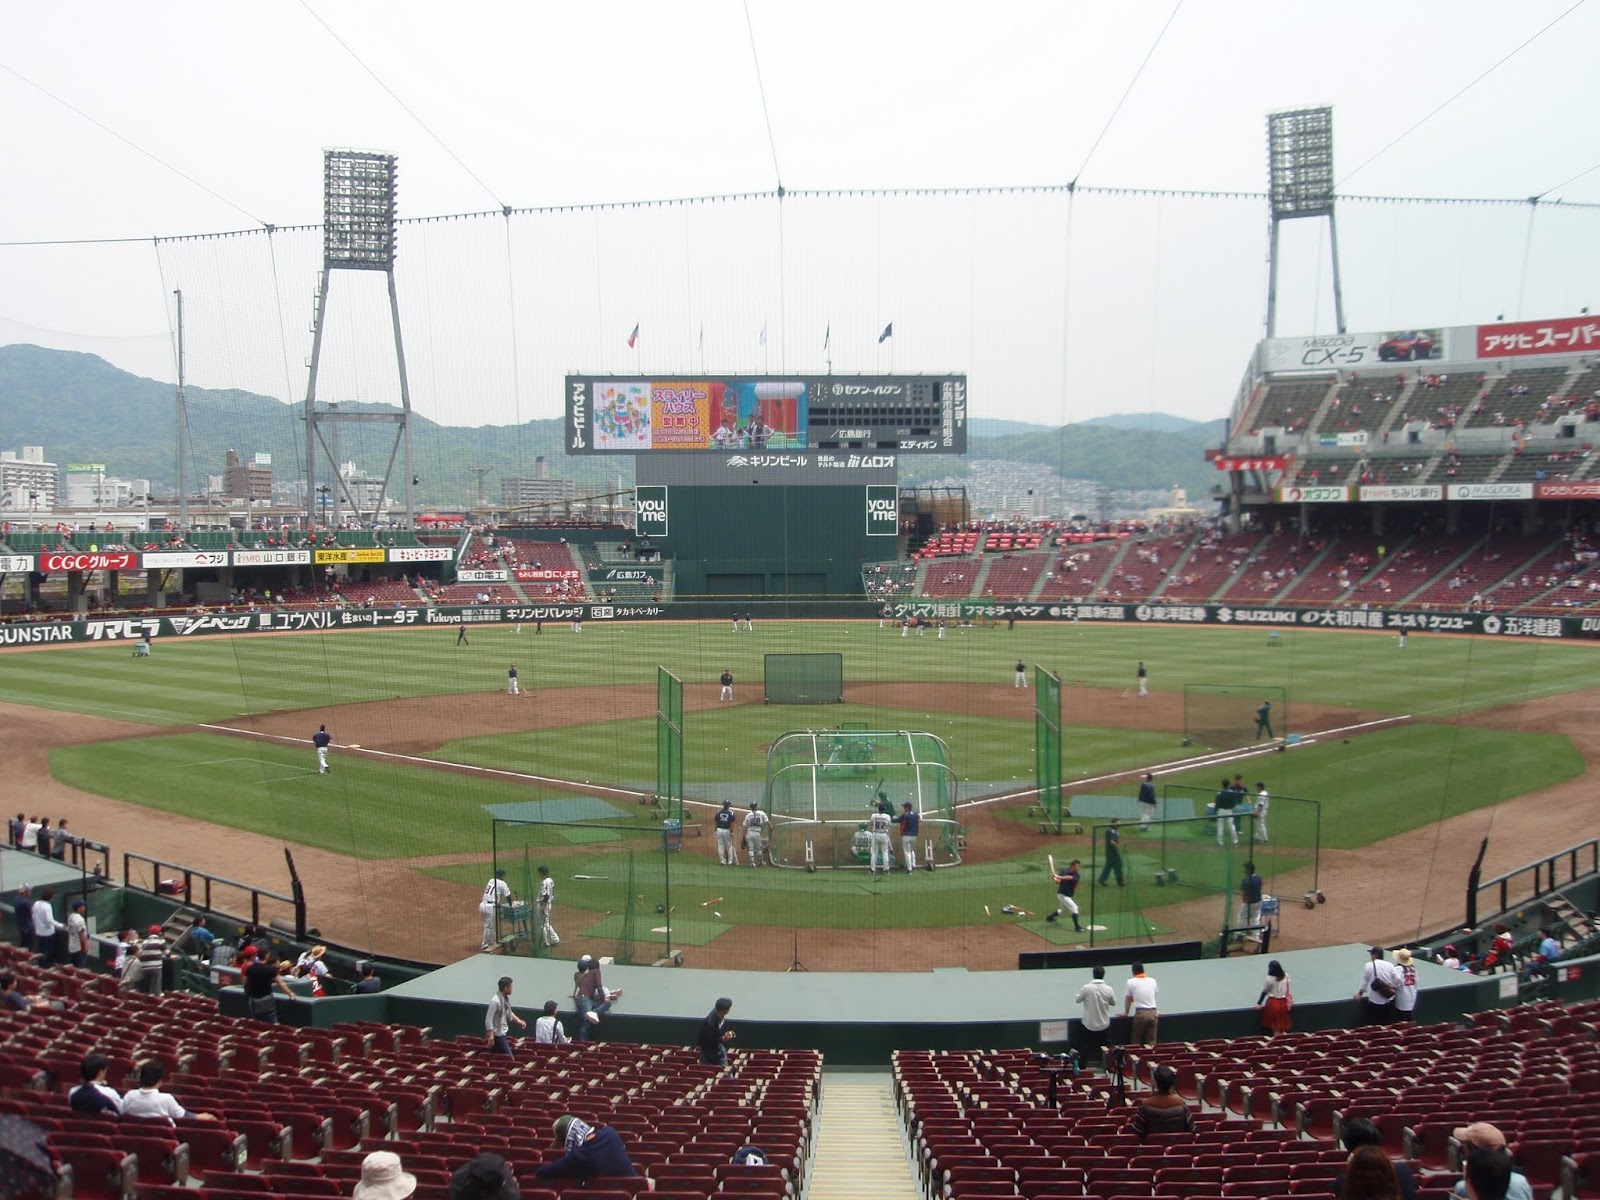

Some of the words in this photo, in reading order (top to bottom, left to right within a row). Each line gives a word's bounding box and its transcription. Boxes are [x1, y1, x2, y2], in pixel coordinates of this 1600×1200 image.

[1302, 346, 1368, 365] CX-5
[653, 389, 706, 402] スライリー
[663, 402, 696, 414] ハウス
[942, 381, 953, 447] 広島市信用組合
[572, 383, 586, 449] アサヒビール
[838, 429, 872, 439] 広島銀行
[900, 440, 938, 450] エディオン
[750, 455, 808, 467] キリンビール
[861, 455, 896, 468] ムロオ
[1303, 488, 1341, 500] オタフク
[1391, 486, 1439, 498] もみじ銀行
[637, 500, 664, 512] you
[868, 499, 895, 512] you
[642, 511, 666, 522] me
[873, 509, 897, 521] me
[48, 555, 129, 570] CGCグループ
[208, 554, 224, 564] フジ
[263, 552, 307, 563] 山口銀行
[317, 552, 347, 561] 東洋水産
[0, 557, 28, 571] 電力
[474, 571, 504, 580] 中電工
[617, 571, 646, 579] 広島ガス
[427, 608, 461, 624] Fukuya
[506, 606, 584, 619] キリンビバレッジ
[616, 607, 664, 616] タカキベーカリー
[965, 605, 1012, 616] フマキラー
[1234, 611, 1296, 622] SUZUKI
[276, 612, 336, 630] ユウベル
[1320, 610, 1384, 628] 大和興産
[1429, 615, 1474, 629] ケンユー
[86, 619, 160, 640] クマヒラ
[1503, 617, 1562, 637] 五洋建設
[0, 625, 73, 645] SUNSTAR
[875, 821, 886, 830] 82
